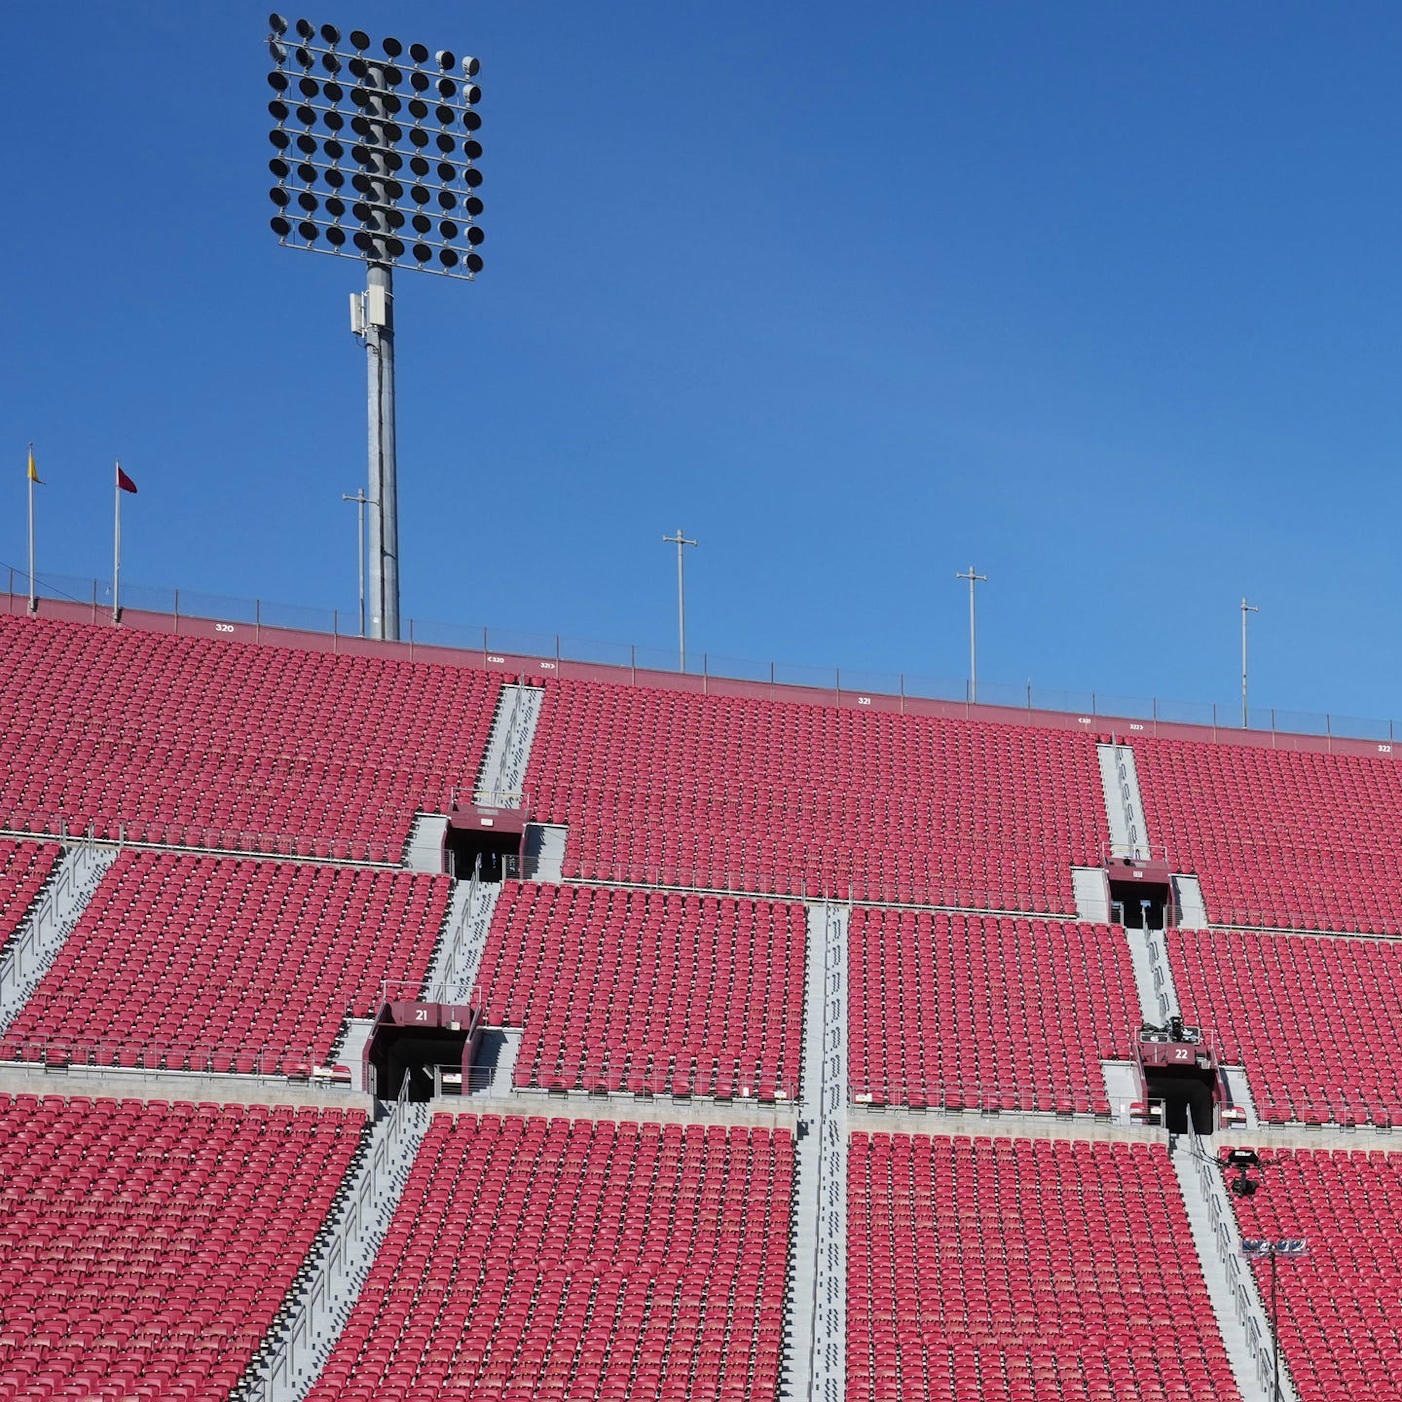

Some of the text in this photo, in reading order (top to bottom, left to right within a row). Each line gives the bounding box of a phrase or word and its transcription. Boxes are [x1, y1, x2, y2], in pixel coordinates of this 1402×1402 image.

[216, 624, 234, 632] 320
[858, 697, 871, 705] 321
[1378, 745, 1391, 753] 322
[416, 1010, 427, 1021] 21
[1175, 1049, 1188, 1059] 22
